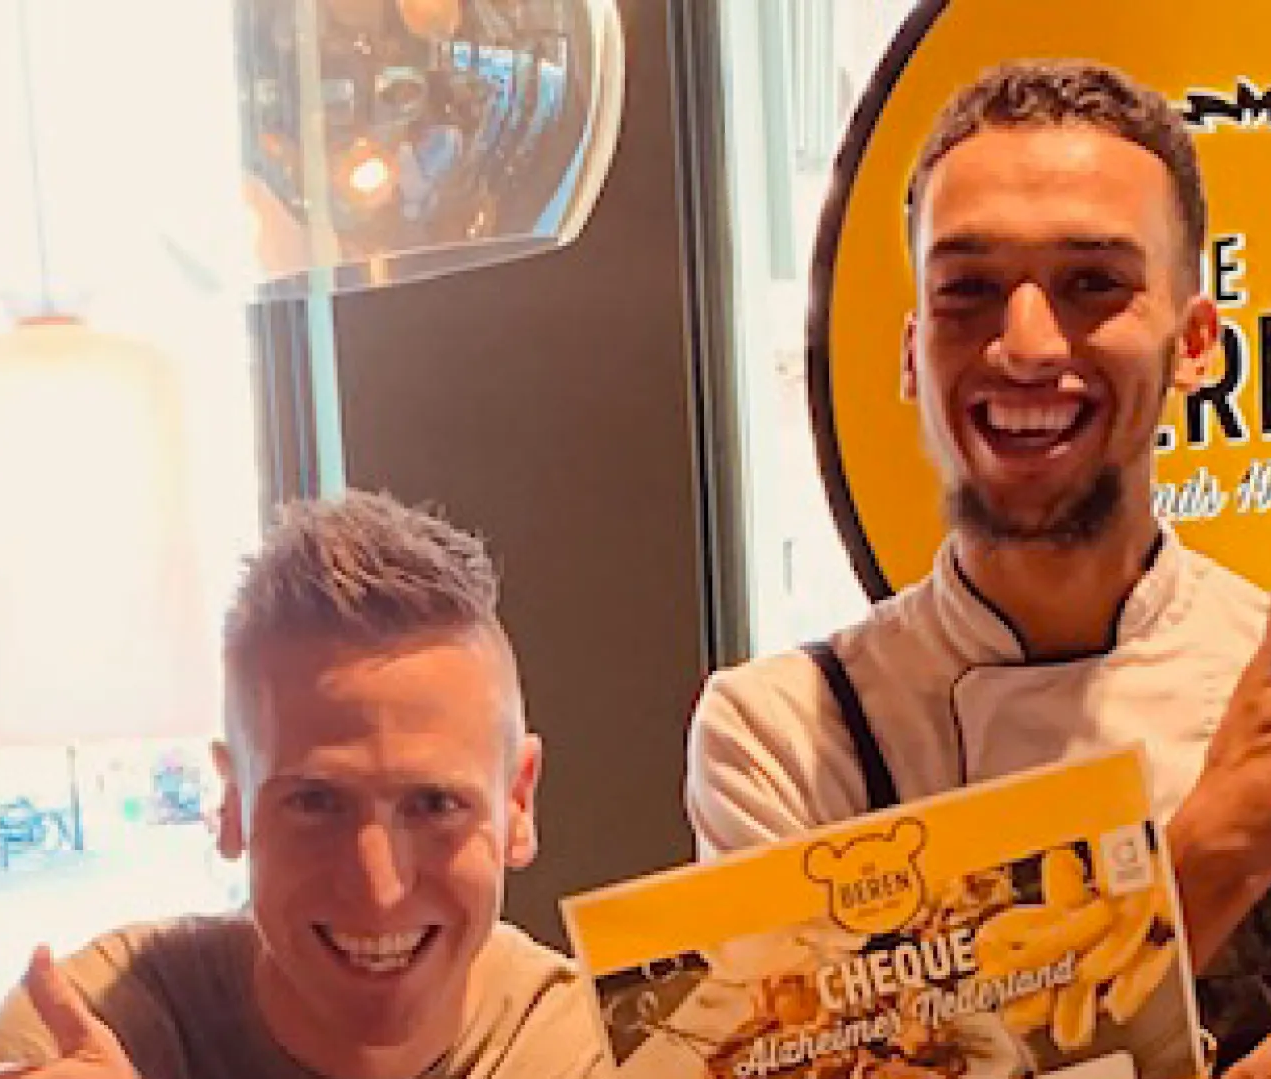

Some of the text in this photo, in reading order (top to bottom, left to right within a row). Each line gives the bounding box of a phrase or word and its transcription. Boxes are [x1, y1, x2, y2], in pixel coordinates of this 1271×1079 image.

[732, 949, 1077, 1078] Alzheimer Nederland
[817, 928, 977, 1013] CHEQUE
